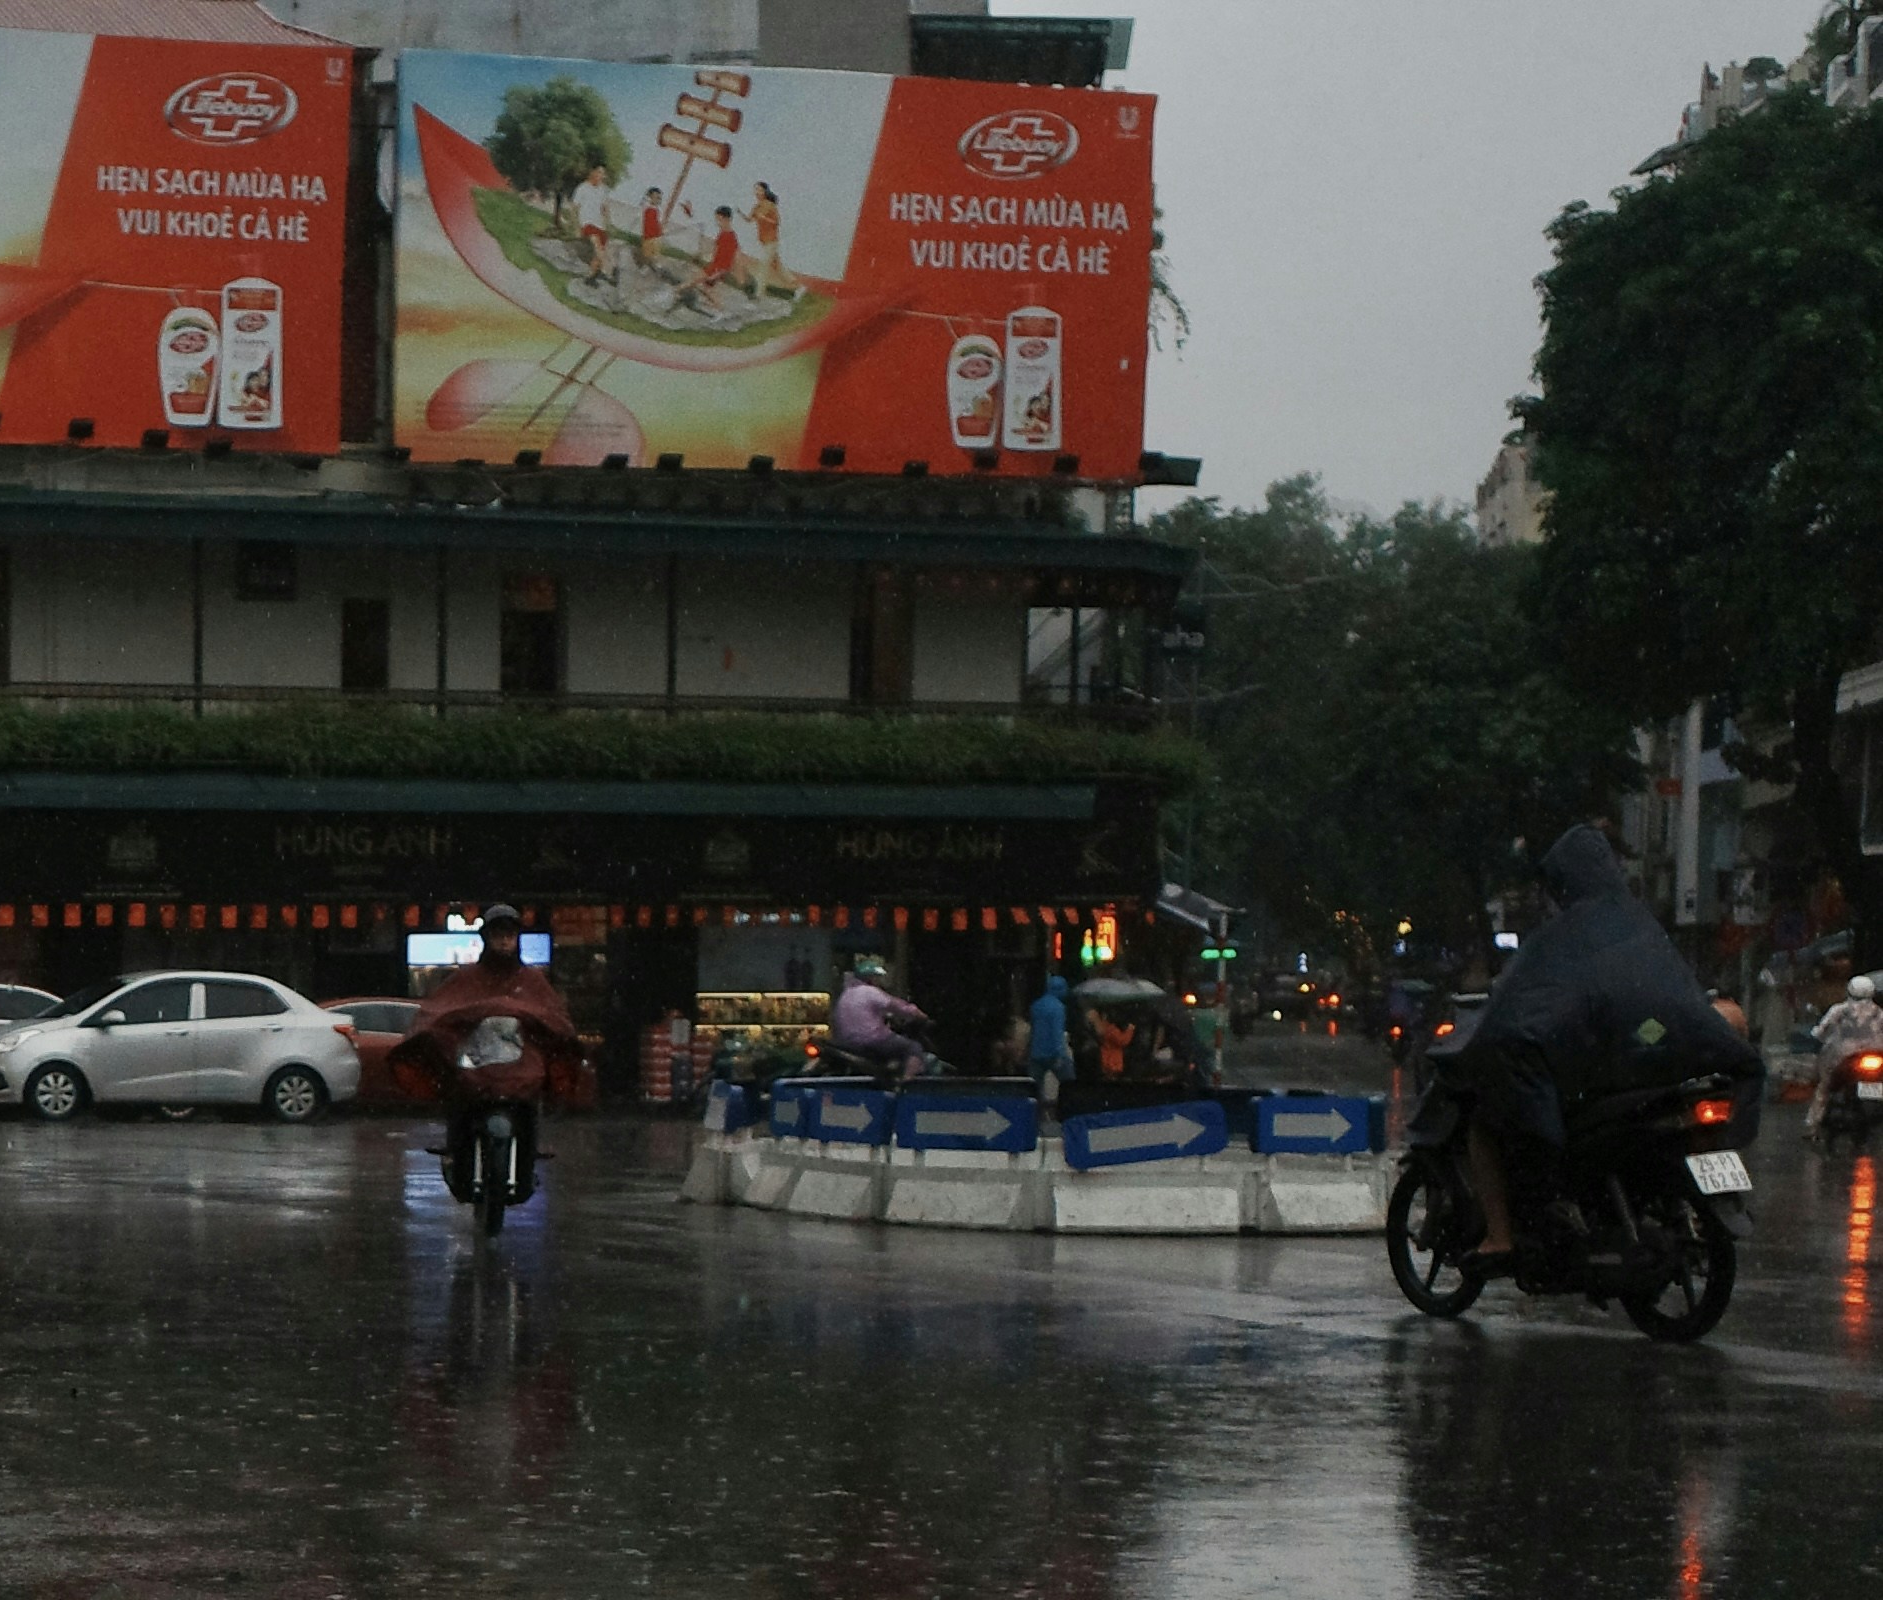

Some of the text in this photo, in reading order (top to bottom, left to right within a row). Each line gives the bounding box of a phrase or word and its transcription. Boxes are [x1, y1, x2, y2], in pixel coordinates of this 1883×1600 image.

[97, 165, 328, 206] HẸN SẠCH MÙA HẠ
[117, 208, 160, 236] VUI
[278, 210, 310, 243] HÈ
[889, 192, 1130, 235] HẸN SẠCH MÙA HẠ
[910, 239, 955, 269] VUI
[1078, 240, 1110, 275] HÈ
